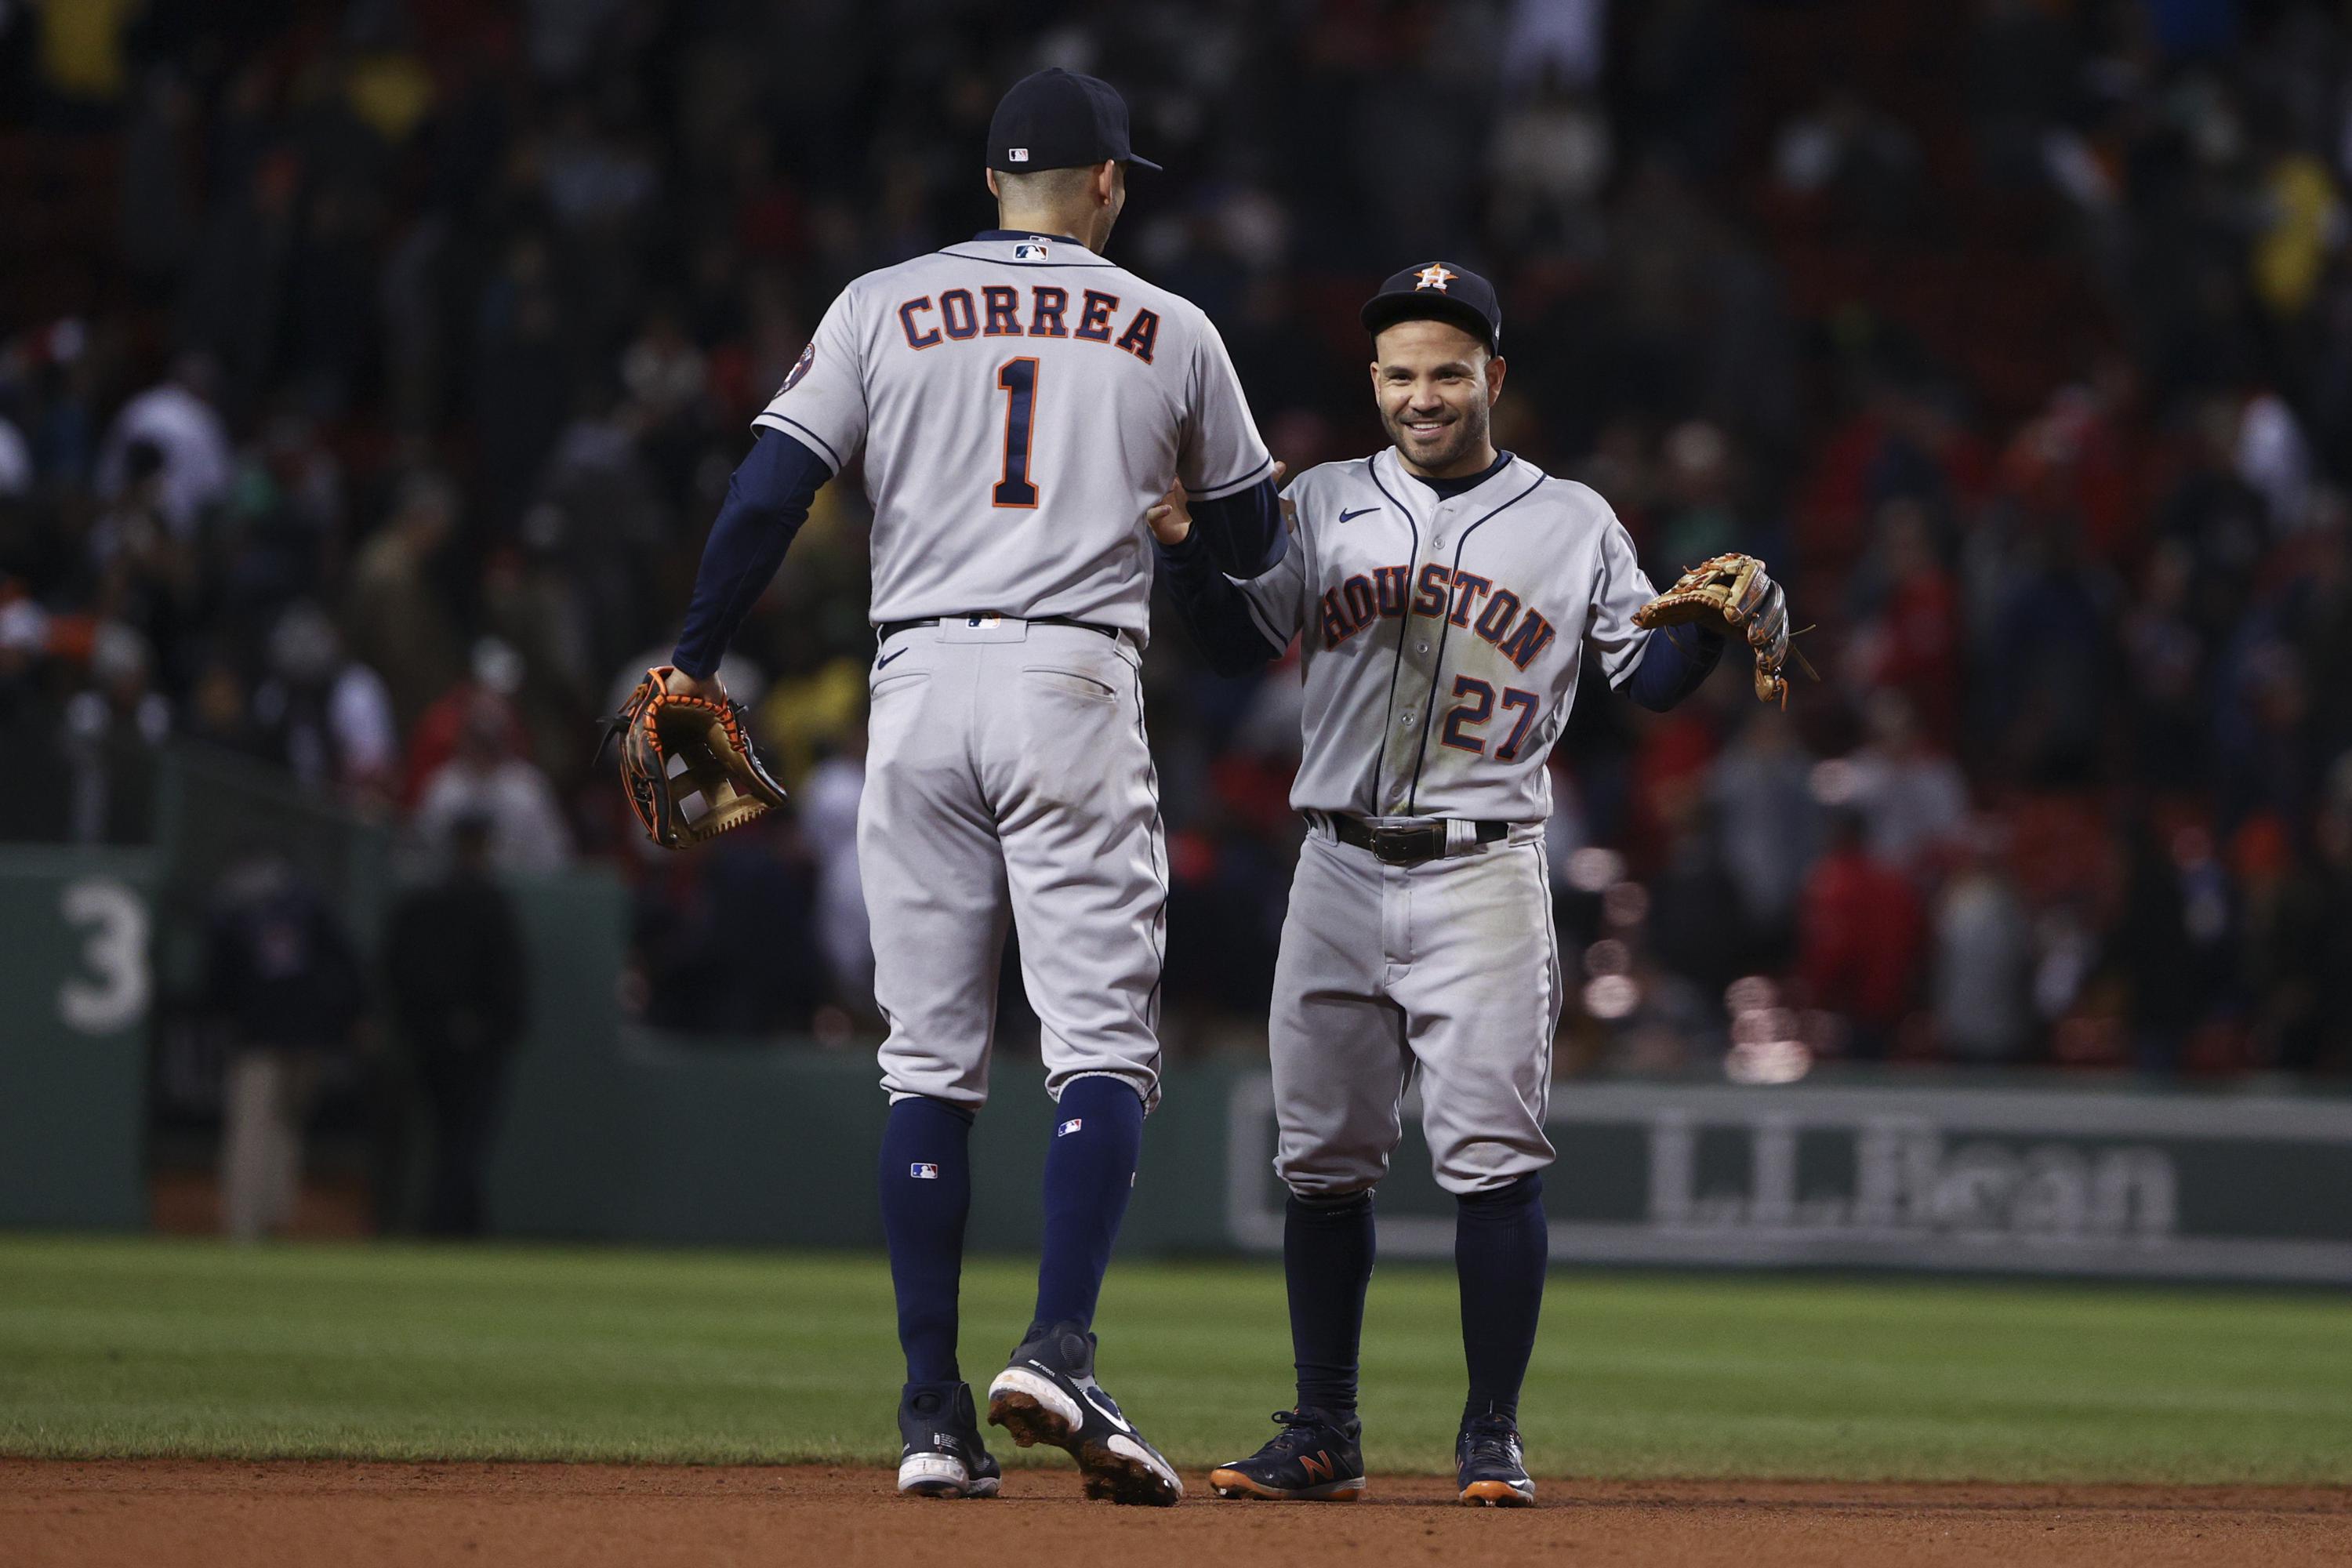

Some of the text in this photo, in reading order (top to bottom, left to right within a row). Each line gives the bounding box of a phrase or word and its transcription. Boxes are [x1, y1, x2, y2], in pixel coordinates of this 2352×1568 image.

[1417, 267, 1451, 289] H
[898, 285, 1160, 365] CORREA
[992, 356, 1040, 509] 1
[1321, 562, 1556, 672] HOUSTON
[1440, 674, 1540, 760] 27
[60, 877, 150, 1036] 3
[1298, 1450, 1334, 1486] N
